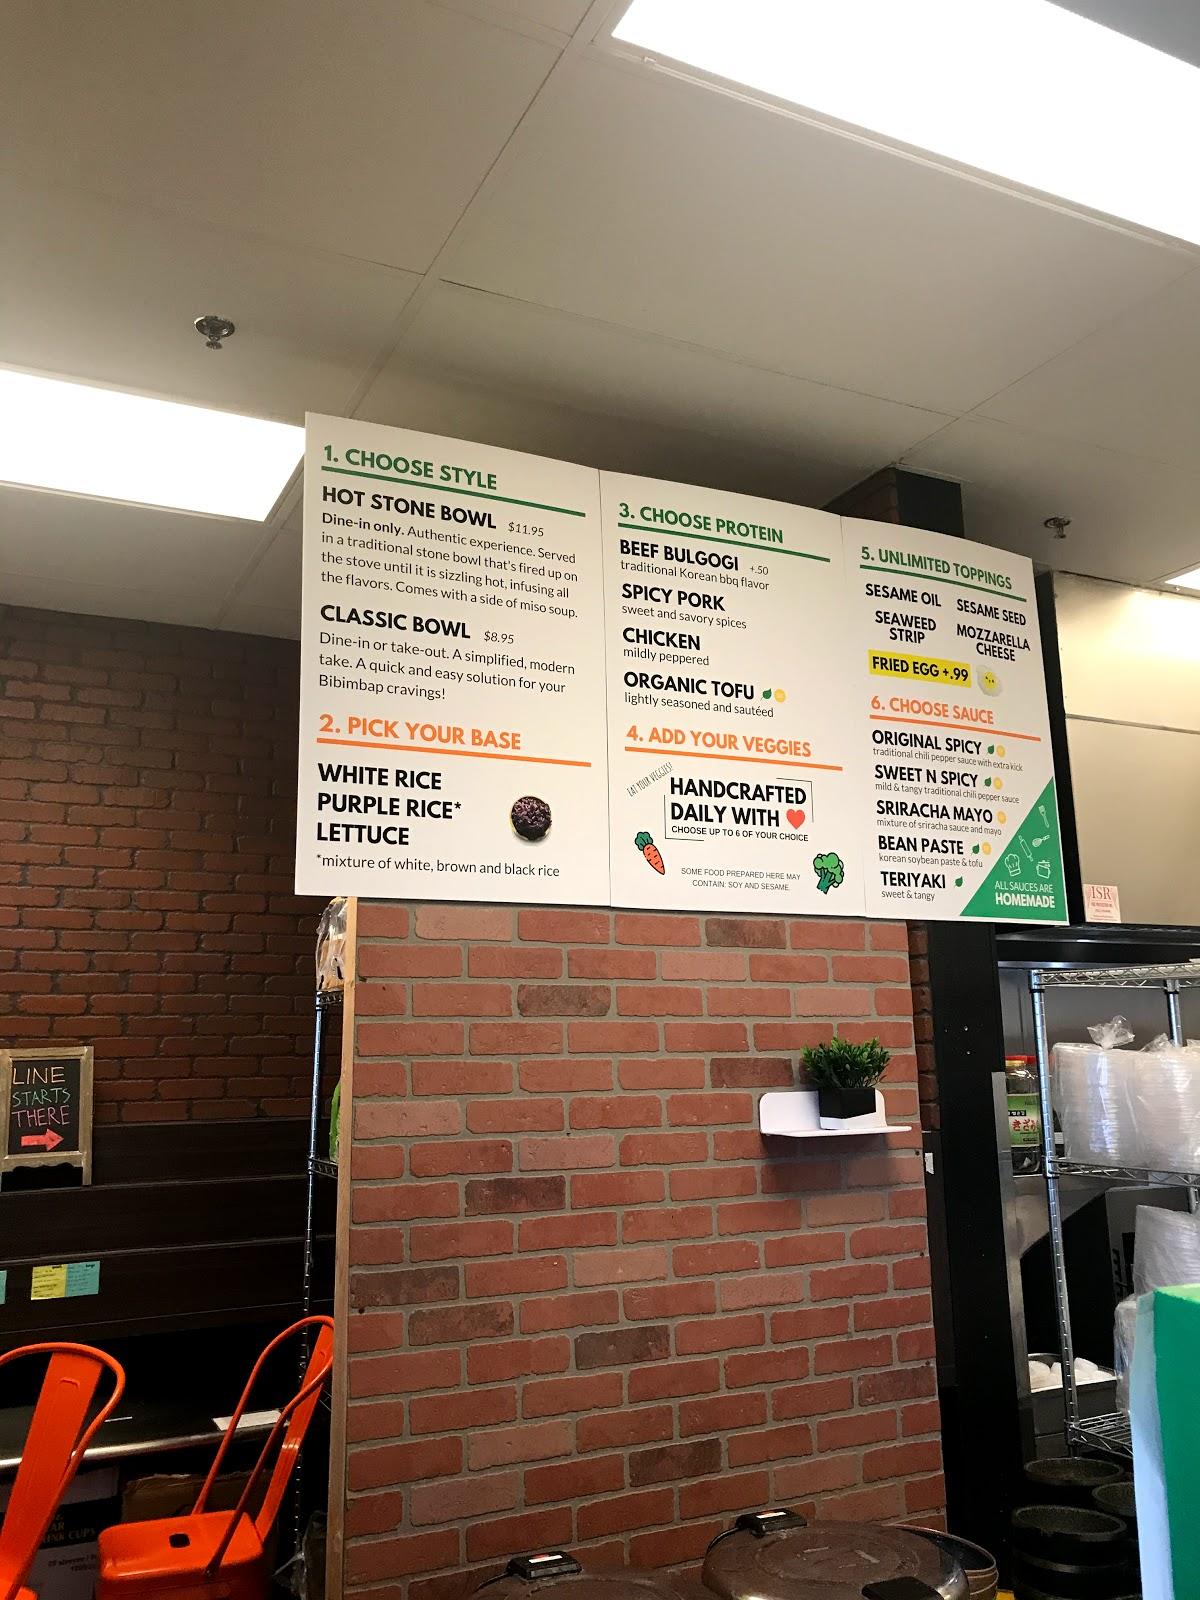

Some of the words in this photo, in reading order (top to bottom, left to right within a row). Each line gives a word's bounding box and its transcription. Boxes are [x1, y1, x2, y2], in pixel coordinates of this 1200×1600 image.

[324, 445, 338, 462] 1.
[346, 449, 433, 478] CHOOSE
[440, 465, 496, 490] STYLE
[323, 486, 365, 506] HOT
[371, 494, 435, 518] STONE
[441, 505, 496, 529] BOWL
[508, 522, 544, 536] $11.95
[619, 503, 635, 518] 3.
[640, 506, 711, 531] CHOOSE
[716, 518, 783, 543] PROTEIN
[323, 512, 370, 530] Dine-in
[374, 523, 404, 536] only.
[407, 526, 467, 545] Authentic
[470, 539, 535, 556] experience.
[538, 548, 575, 563] Served
[322, 532, 333, 543] in
[337, 537, 343, 545] a
[348, 536, 412, 555] traditional
[416, 548, 450, 561] stone
[453, 552, 480, 566] bowl
[484, 557, 516, 571] that's
[519, 562, 545, 576] fired
[548, 570, 561, 580] up
[564, 573, 577, 582] on
[620, 539, 658, 558] BEEF
[664, 546, 738, 571] BULGOGI
[321, 552, 342, 564] the
[346, 556, 380, 569] stove
[384, 560, 411, 574] until
[416, 565, 423, 576] it
[427, 566, 436, 578] is
[439, 569, 482, 587] sizzling
[486, 575, 507, 590] hot,
[510, 579, 554, 598] infusing
[557, 588, 568, 598] all
[621, 560, 676, 576] traditional
[680, 568, 717, 582] Korean
[720, 573, 738, 588] bbq
[741, 577, 769, 590] flavor
[862, 546, 874, 561] 5.
[879, 549, 950, 573] UNLIMITED
[953, 563, 1012, 590] TOPPINGS
[622, 583, 672, 603] SPICY
[678, 590, 725, 611] PORK
[866, 583, 918, 602] SESAME
[921, 592, 941, 607] OIL
[622, 606, 654, 617] sweet
[658, 610, 676, 619] and
[679, 613, 714, 626] savory
[716, 617, 746, 629] spices
[875, 611, 936, 631] SEAWEED
[957, 599, 999, 620] SESAME
[1002, 610, 1026, 625] SEED
[321, 605, 407, 630] CLASSIC
[413, 616, 470, 638] BOWL
[484, 630, 514, 644] $8.95
[890, 628, 925, 644] STRIP
[623, 627, 700, 650] CHICKEN
[957, 624, 1030, 651] MOZZARELLA
[320, 632, 370, 649] Dine-in
[374, 642, 388, 650] or
[391, 642, 449, 658] take-out.
[452, 649, 462, 660] A
[465, 651, 526, 670] simplified,
[530, 661, 574, 674] modern
[624, 648, 656, 661] mildly
[660, 653, 709, 665] peppered
[976, 642, 1015, 661] CHEESE
[873, 656, 909, 672] FRIED
[913, 662, 939, 676] EGG
[320, 674, 383, 694] Bibimbap
[387, 685, 444, 700] cravings!
[624, 672, 707, 694] ORGANIC
[711, 681, 754, 700] TOFU
[871, 696, 885, 710] 6.
[890, 698, 948, 718] CHOOSE
[953, 705, 994, 724] SAUCE
[320, 714, 340, 733] 2.
[348, 716, 400, 738] PICK
[405, 722, 465, 744] YOUR
[472, 729, 520, 750] BASE
[626, 725, 643, 742] 4.
[648, 727, 686, 744] ADD
[690, 730, 739, 750] YOUR
[742, 736, 811, 757] VEGGIES
[872, 730, 941, 752] ORIGINAL
[946, 738, 982, 755] SPICY
[873, 748, 913, 758] traditional
[915, 751, 929, 760] chili
[931, 755, 956, 763] pepper
[958, 757, 976, 765] sauce
[977, 759, 992, 767] with
[993, 762, 1009, 770] extra
[1010, 762, 1023, 771] kick
[318, 763, 388, 786] WHITE
[396, 770, 441, 790] RICE
[875, 764, 922, 782] SWEET
[926, 769, 936, 783] N
[941, 771, 978, 787] SPICY
[671, 777, 806, 804] HANDCRAFTED
[318, 793, 400, 816] PURPLE
[671, 802, 727, 823] DAILY
[731, 807, 779, 827] WITH
[877, 800, 950, 819] SRIRACHA
[954, 806, 992, 823] MAYO
[317, 822, 409, 845] LETTUCE
[672, 826, 706, 834] CHOOSE
[755, 831, 777, 839] YOUR
[779, 833, 808, 841] CHOICE
[878, 835, 917, 852] BEAN
[922, 838, 964, 854] PASTE
[378, 858, 391, 868] of
[394, 858, 433, 872] white,
[437, 860, 476, 872] brown
[480, 863, 501, 874] and
[505, 863, 535, 875] black
[538, 865, 559, 876] rice
[726, 870, 764, 878] PREPARED
[880, 871, 945, 888] TERIYAKI
[995, 881, 1008, 890] ALL
[1010, 882, 1038, 892] SAUCES
[1039, 884, 1053, 893] ARE
[996, 892, 1055, 908] HOMEMADE
[1092, 886, 1111, 900] ISR
[13, 1067, 65, 1084] LINE
[12, 1088, 70, 1107] STARTS
[12, 1105, 70, 1127] THERE
